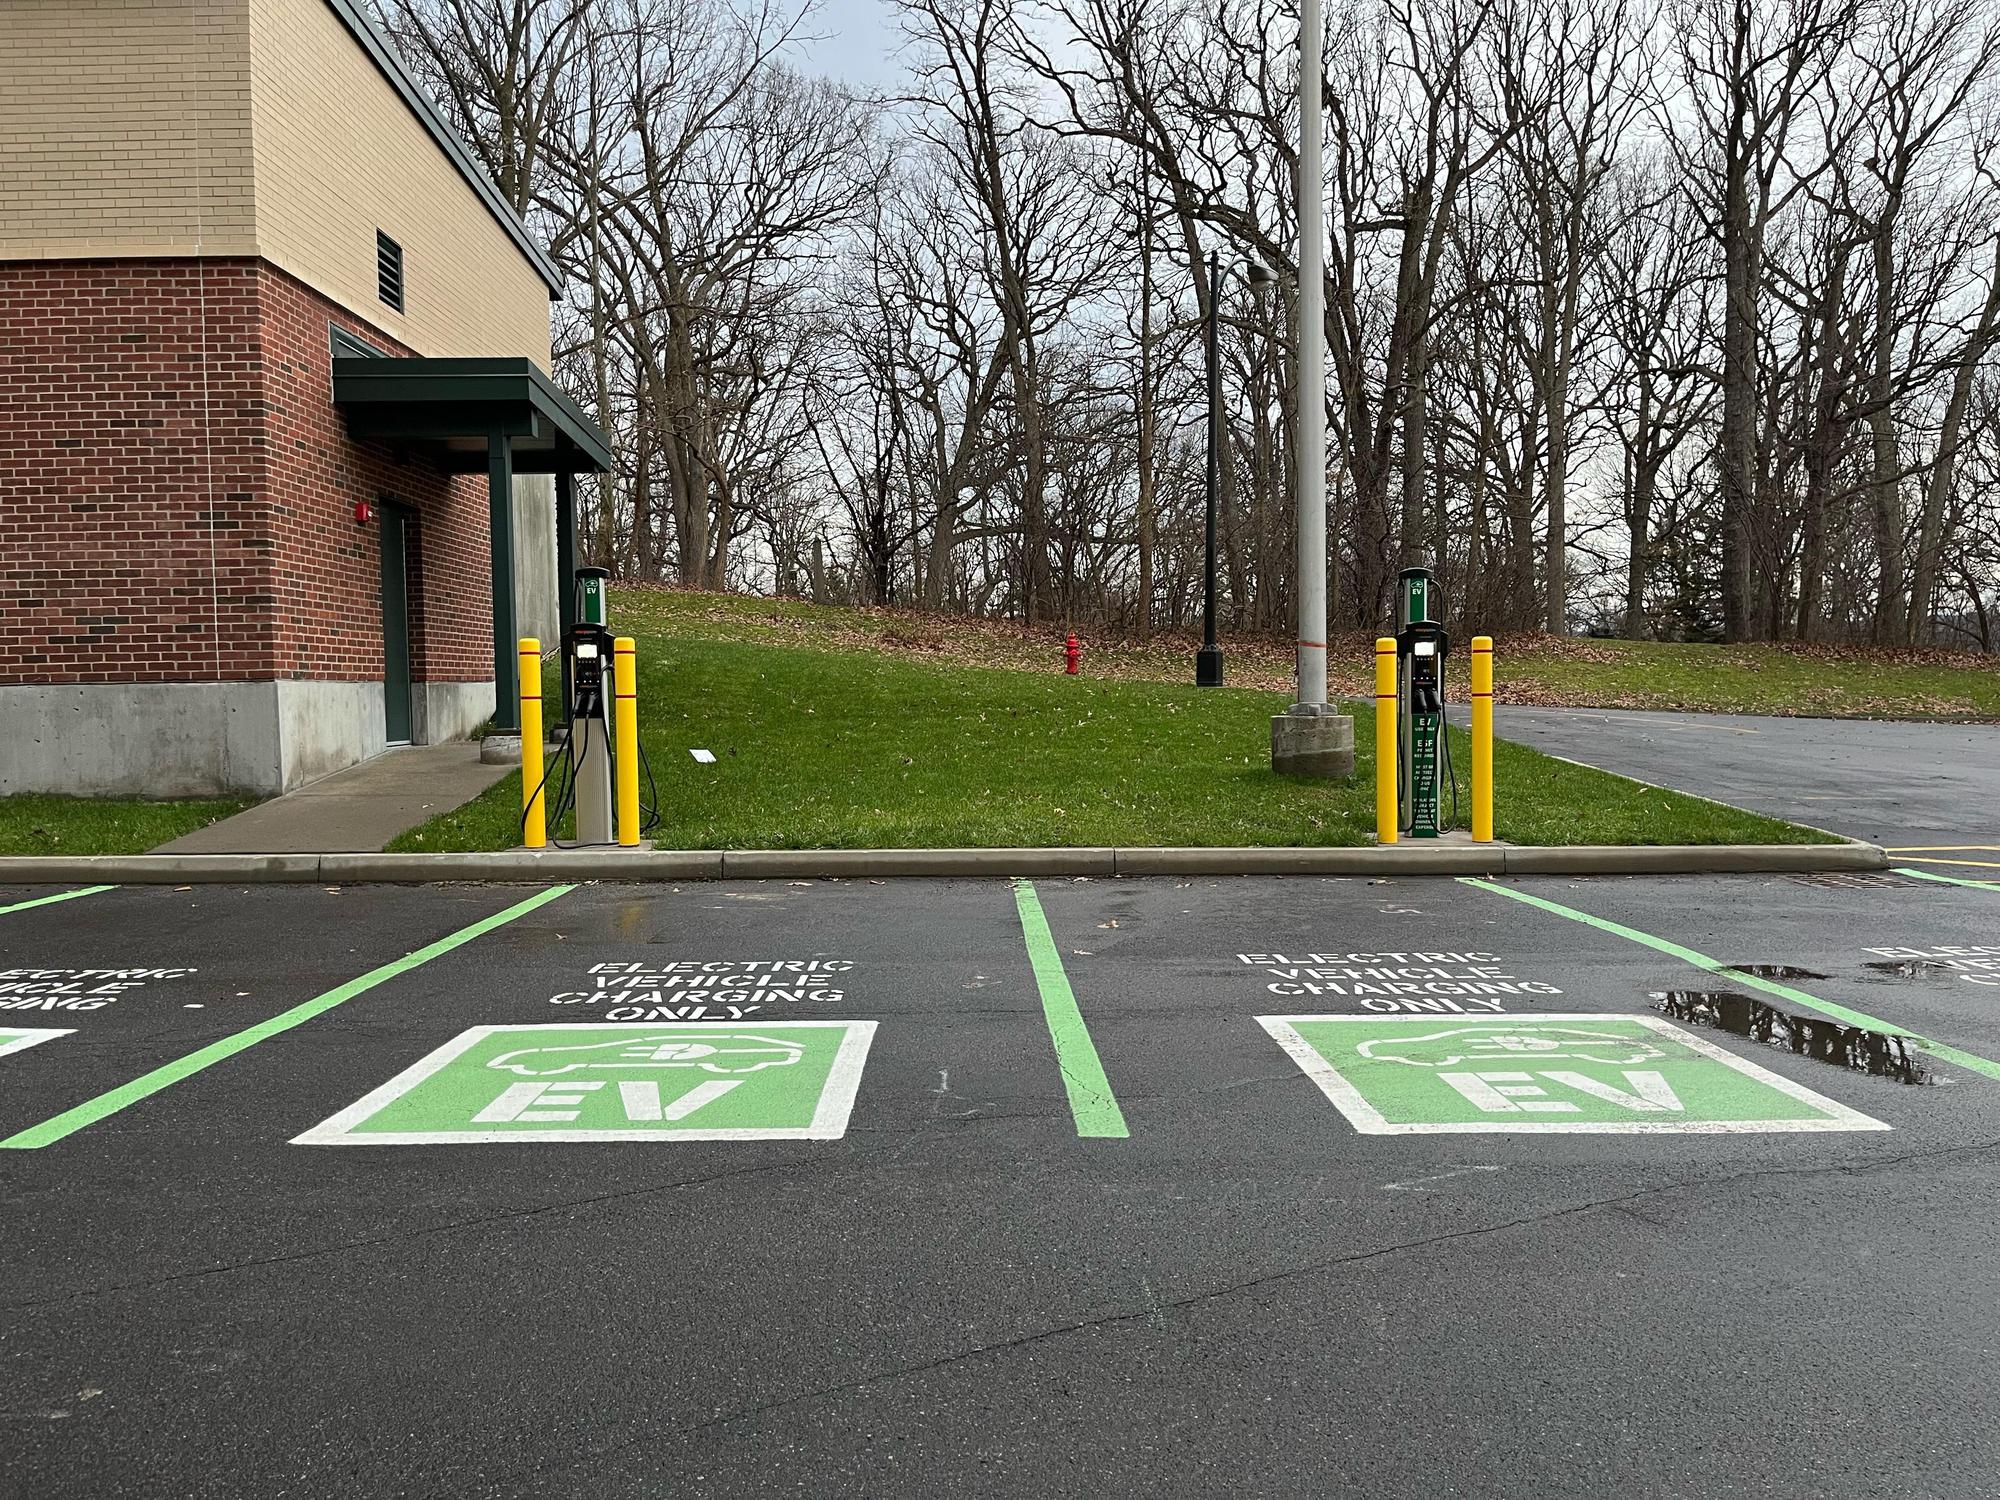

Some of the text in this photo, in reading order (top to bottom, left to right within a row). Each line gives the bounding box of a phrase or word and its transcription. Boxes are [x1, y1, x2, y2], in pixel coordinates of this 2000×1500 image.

[1236, 952, 1502, 964] ELECTRIC
[587, 960, 854, 974] ELECTRIC
[1267, 966, 1516, 980] VEHICLE
[595, 974, 833, 988] VEHICLE
[1267, 981, 1564, 995] CHARGING
[549, 989, 846, 1005] CHARGING
[1360, 998, 1507, 1012] ONLY
[605, 1005, 762, 1021] ONLY
[1436, 1070, 1686, 1113] EV
[469, 1079, 746, 1123] EV
